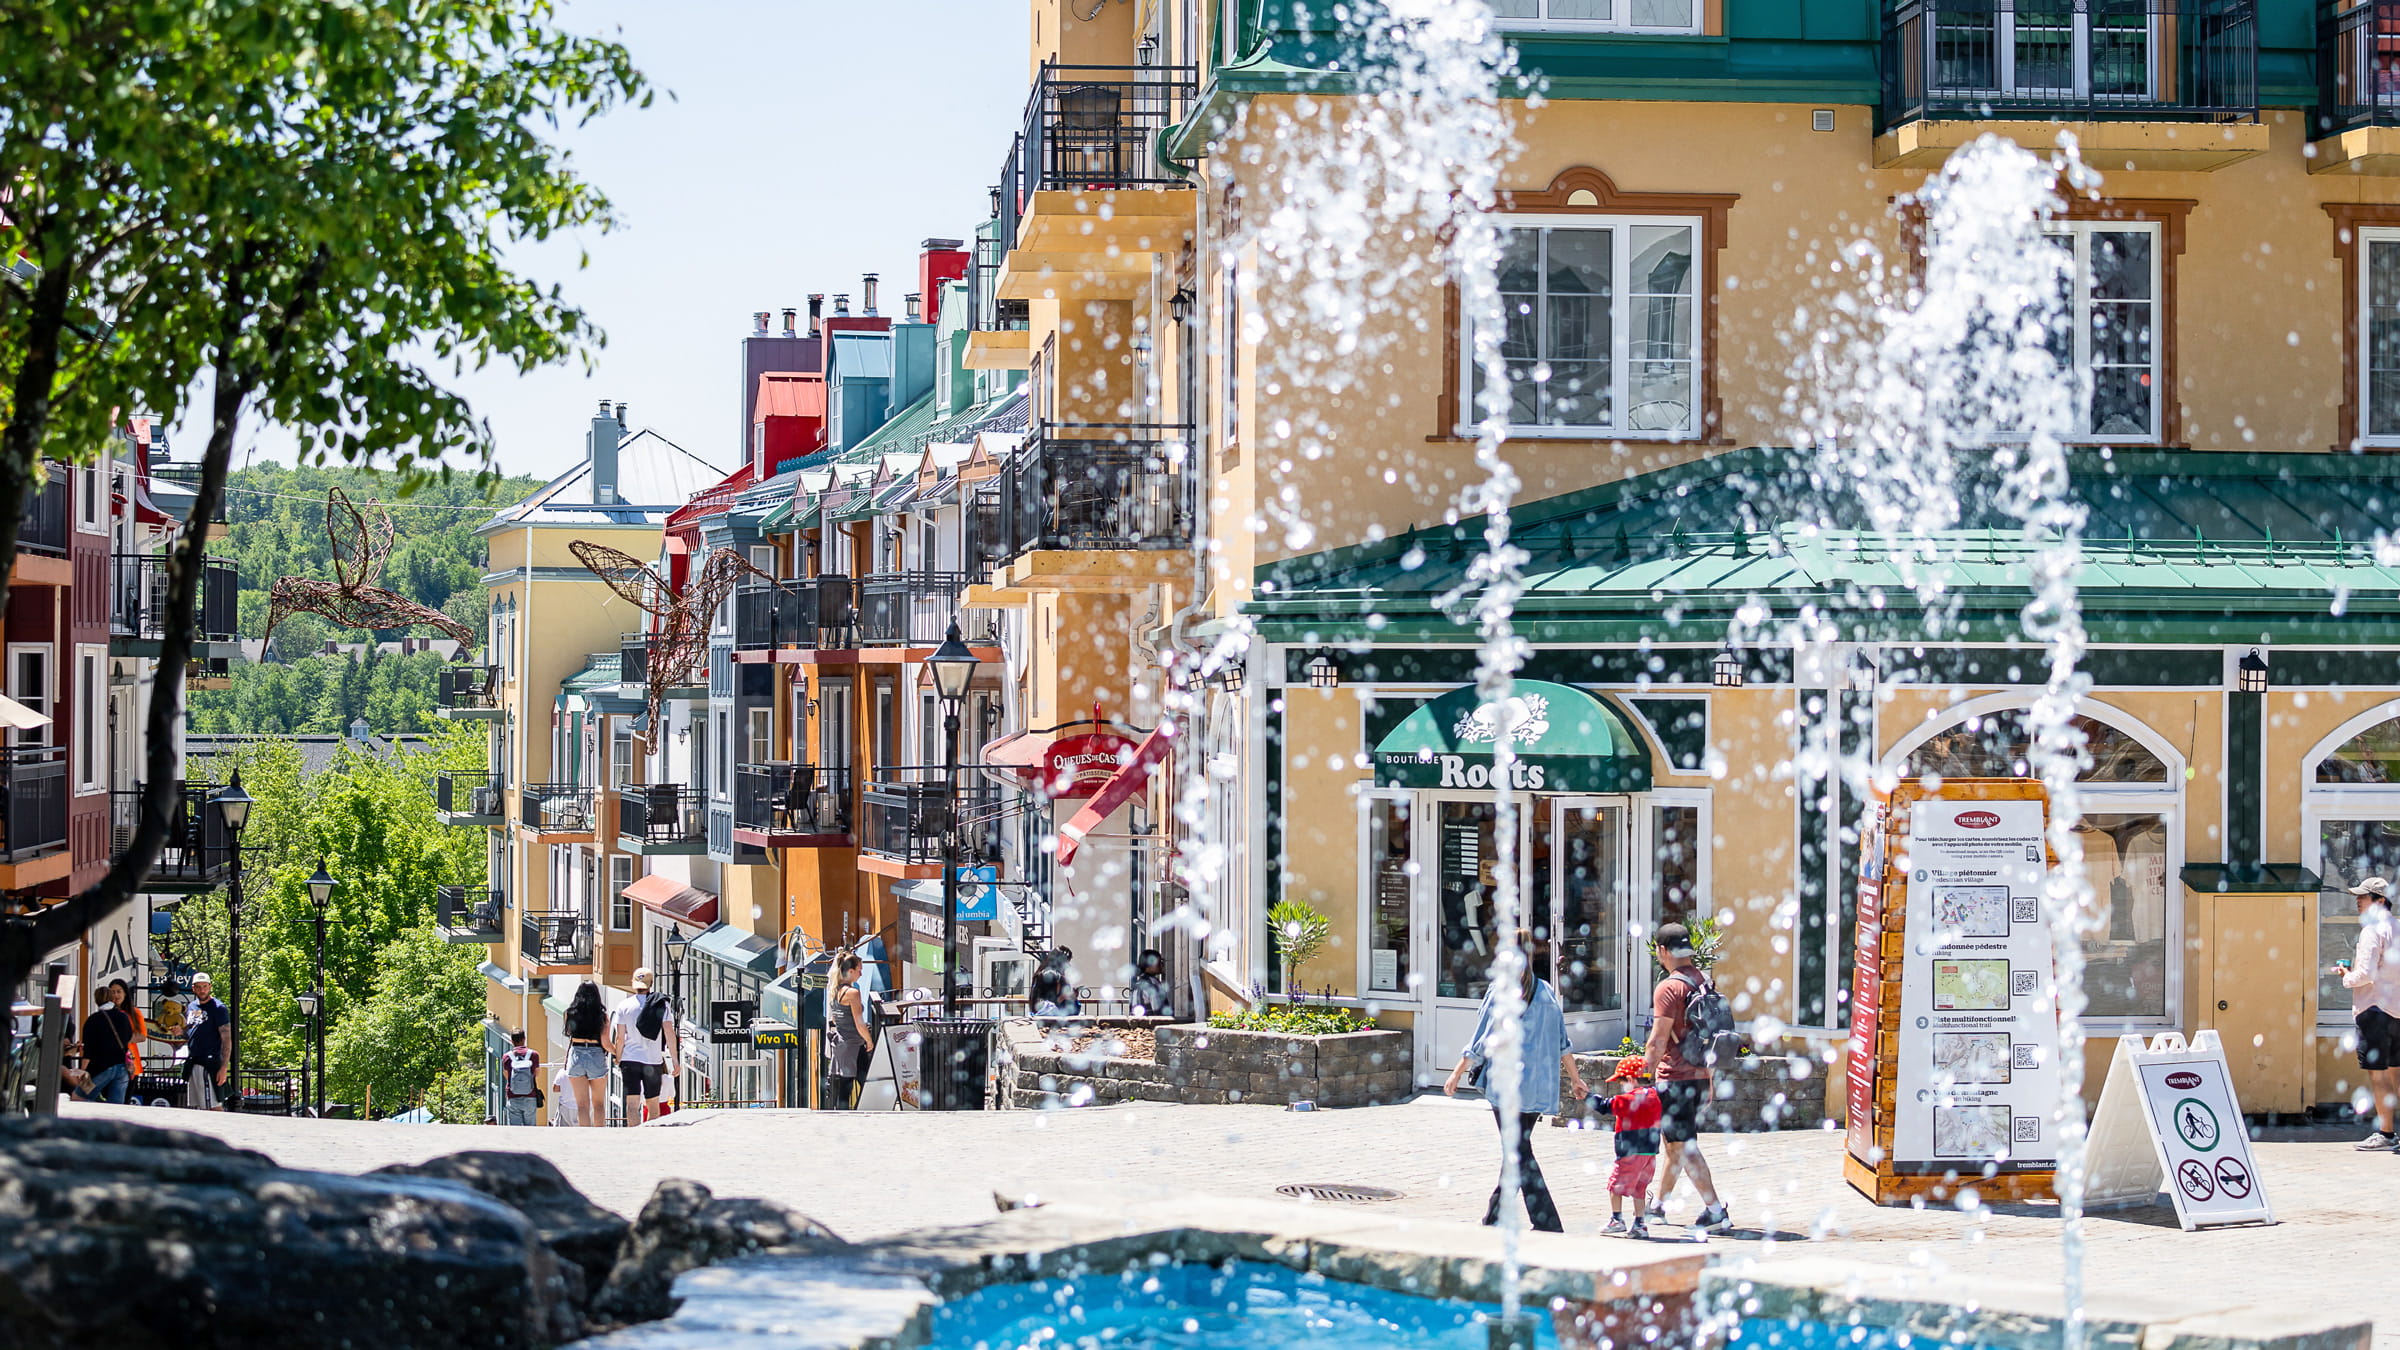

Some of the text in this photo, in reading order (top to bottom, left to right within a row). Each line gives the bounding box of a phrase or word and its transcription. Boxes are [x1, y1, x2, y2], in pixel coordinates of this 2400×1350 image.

[1053, 753, 1092, 769] QUEUES
[1099, 752, 1122, 765] CAST
[1958, 816, 1999, 826] TREMBLANT
[1932, 869, 1998, 878] Vilge piétonnier
[956, 910, 990, 918] olumbia
[1975, 943, 2008, 951] pédestre
[148, 971, 191, 987] Haley
[756, 1033, 780, 1044] Viva
